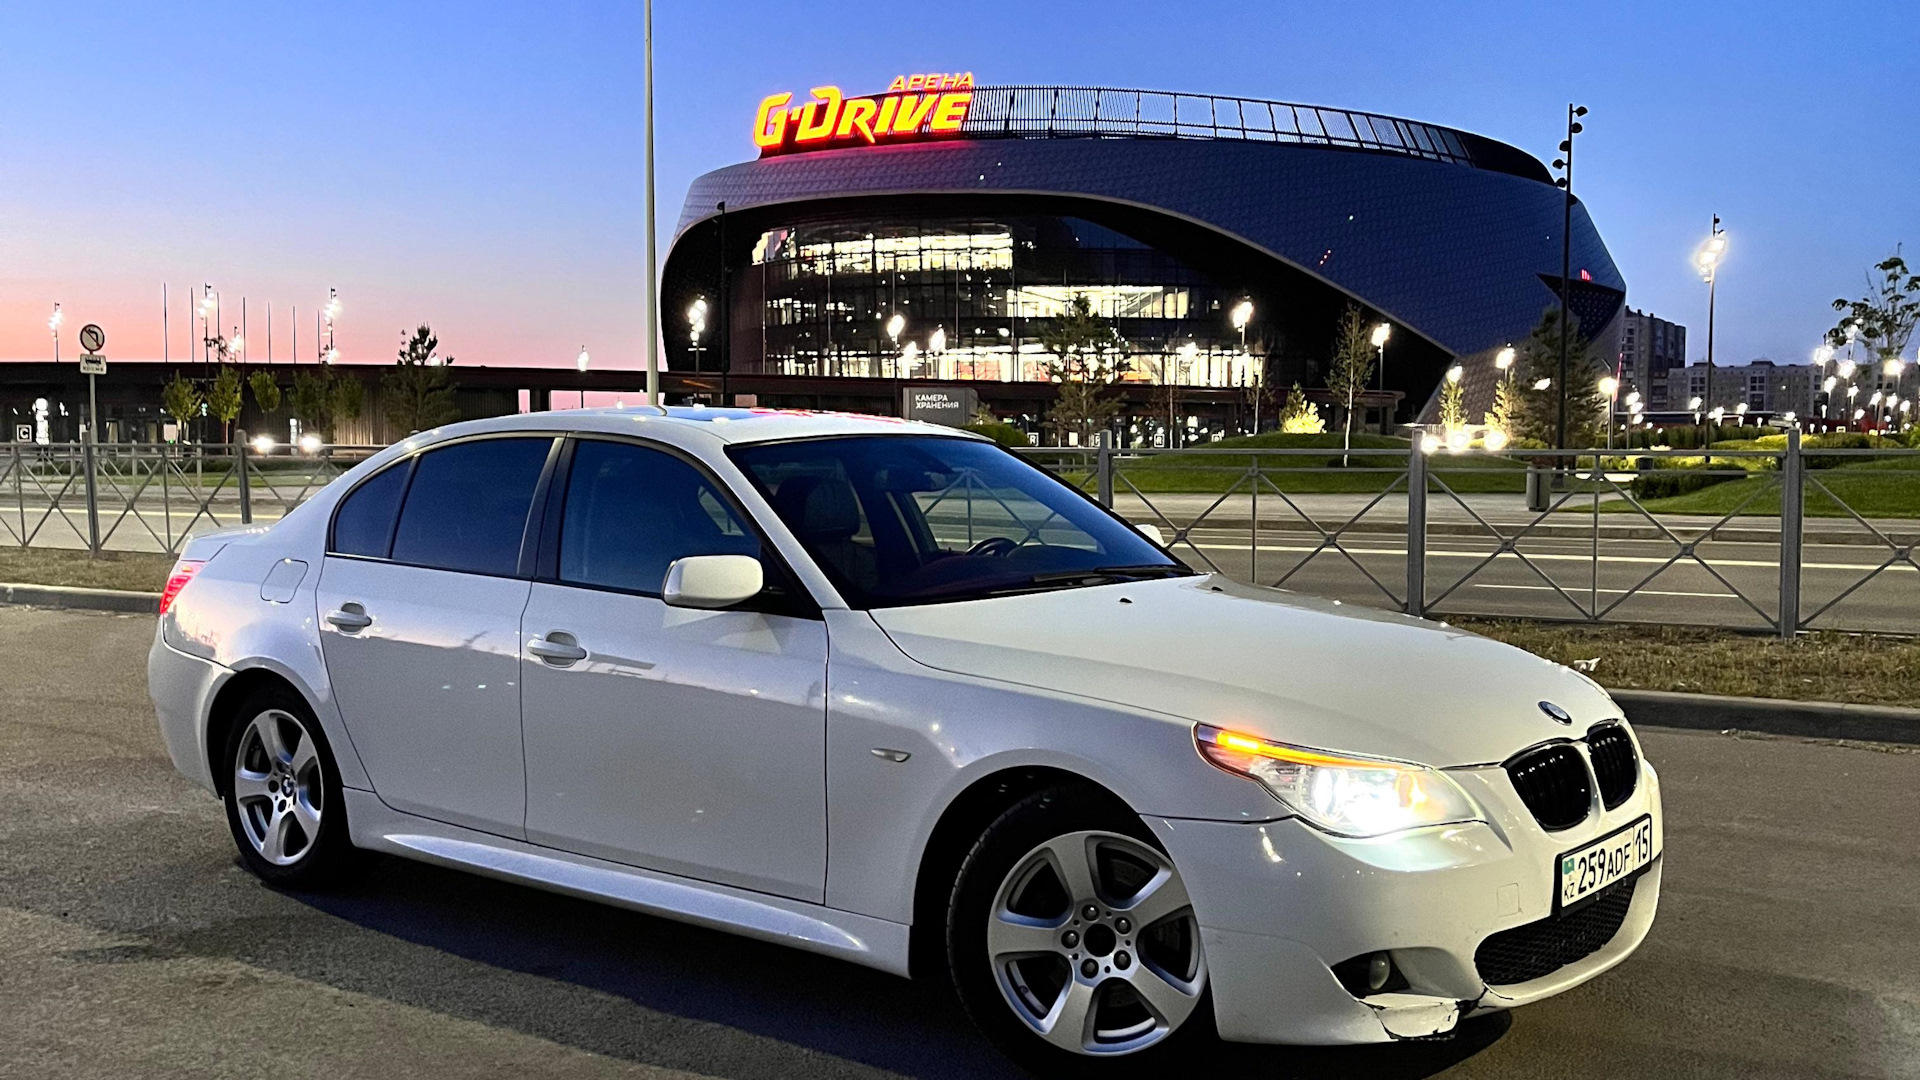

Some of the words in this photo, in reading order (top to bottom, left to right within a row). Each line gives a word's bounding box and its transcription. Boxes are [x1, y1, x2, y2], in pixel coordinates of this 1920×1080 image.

[889, 72, 974, 91] АРЕНА
[915, 394, 948, 402] КАМЕРА
[915, 401, 959, 409] ХРАНЕНИЯ
[1564, 882, 1575, 900] KZ
